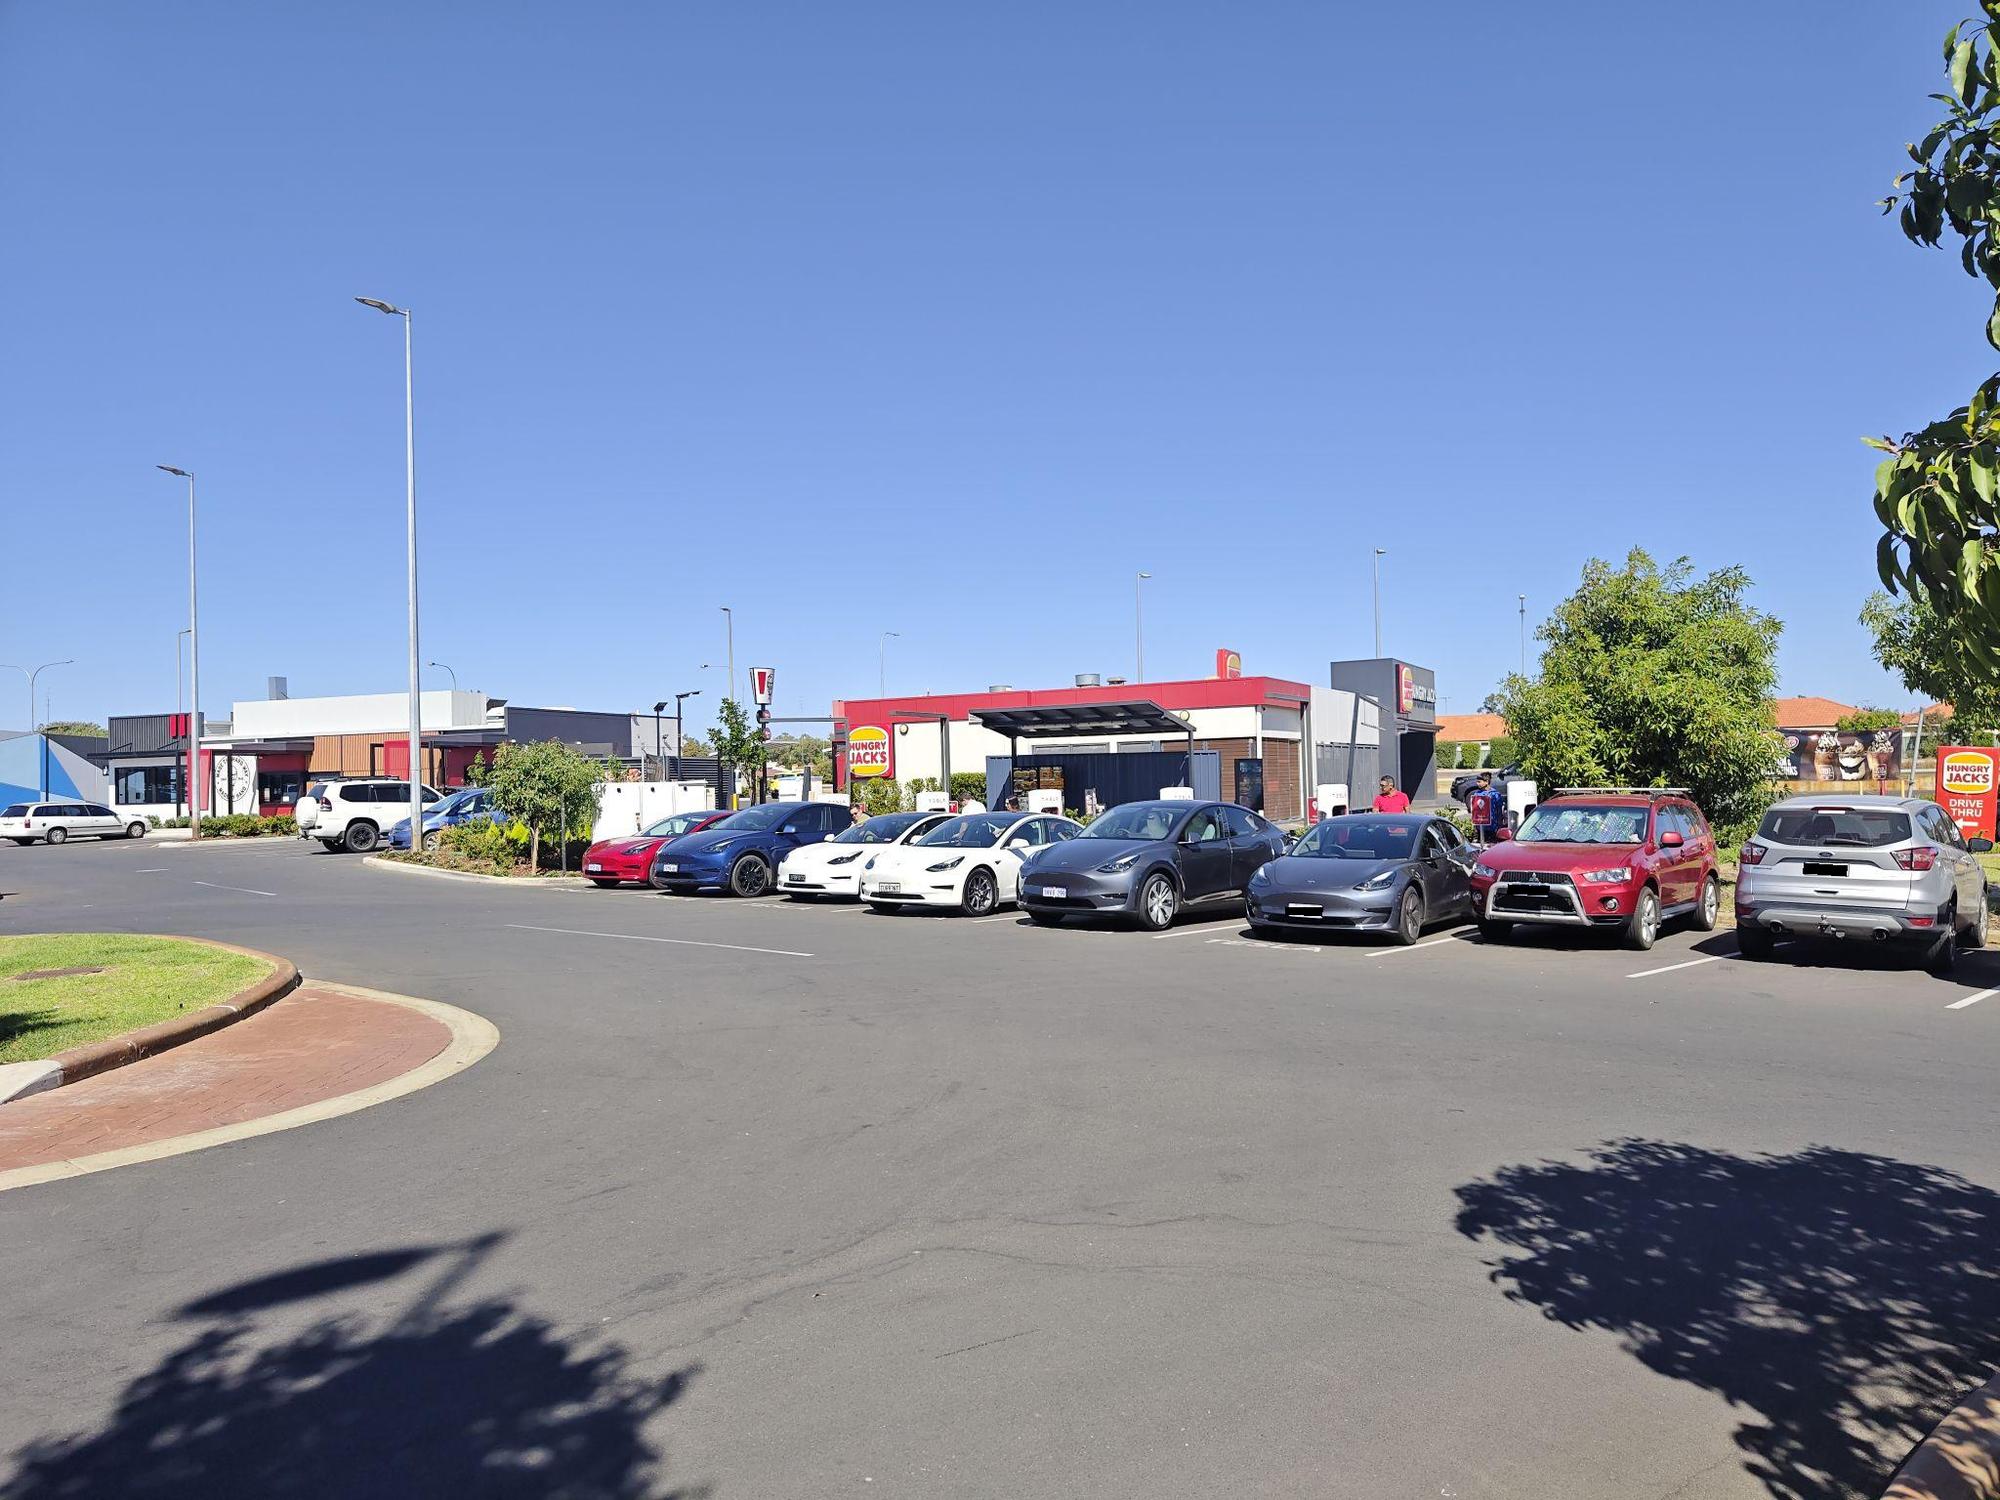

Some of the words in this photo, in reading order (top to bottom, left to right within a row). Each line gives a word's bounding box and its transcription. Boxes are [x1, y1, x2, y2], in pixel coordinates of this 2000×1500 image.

[850, 741, 887, 751] HUNGRY
[850, 751, 887, 765] JACK'S
[1946, 765, 1990, 773] HUNGRY
[1946, 773, 1990, 784] JACK'S
[1949, 799, 1984, 808] DRIVE
[1951, 808, 1983, 817] THRU
